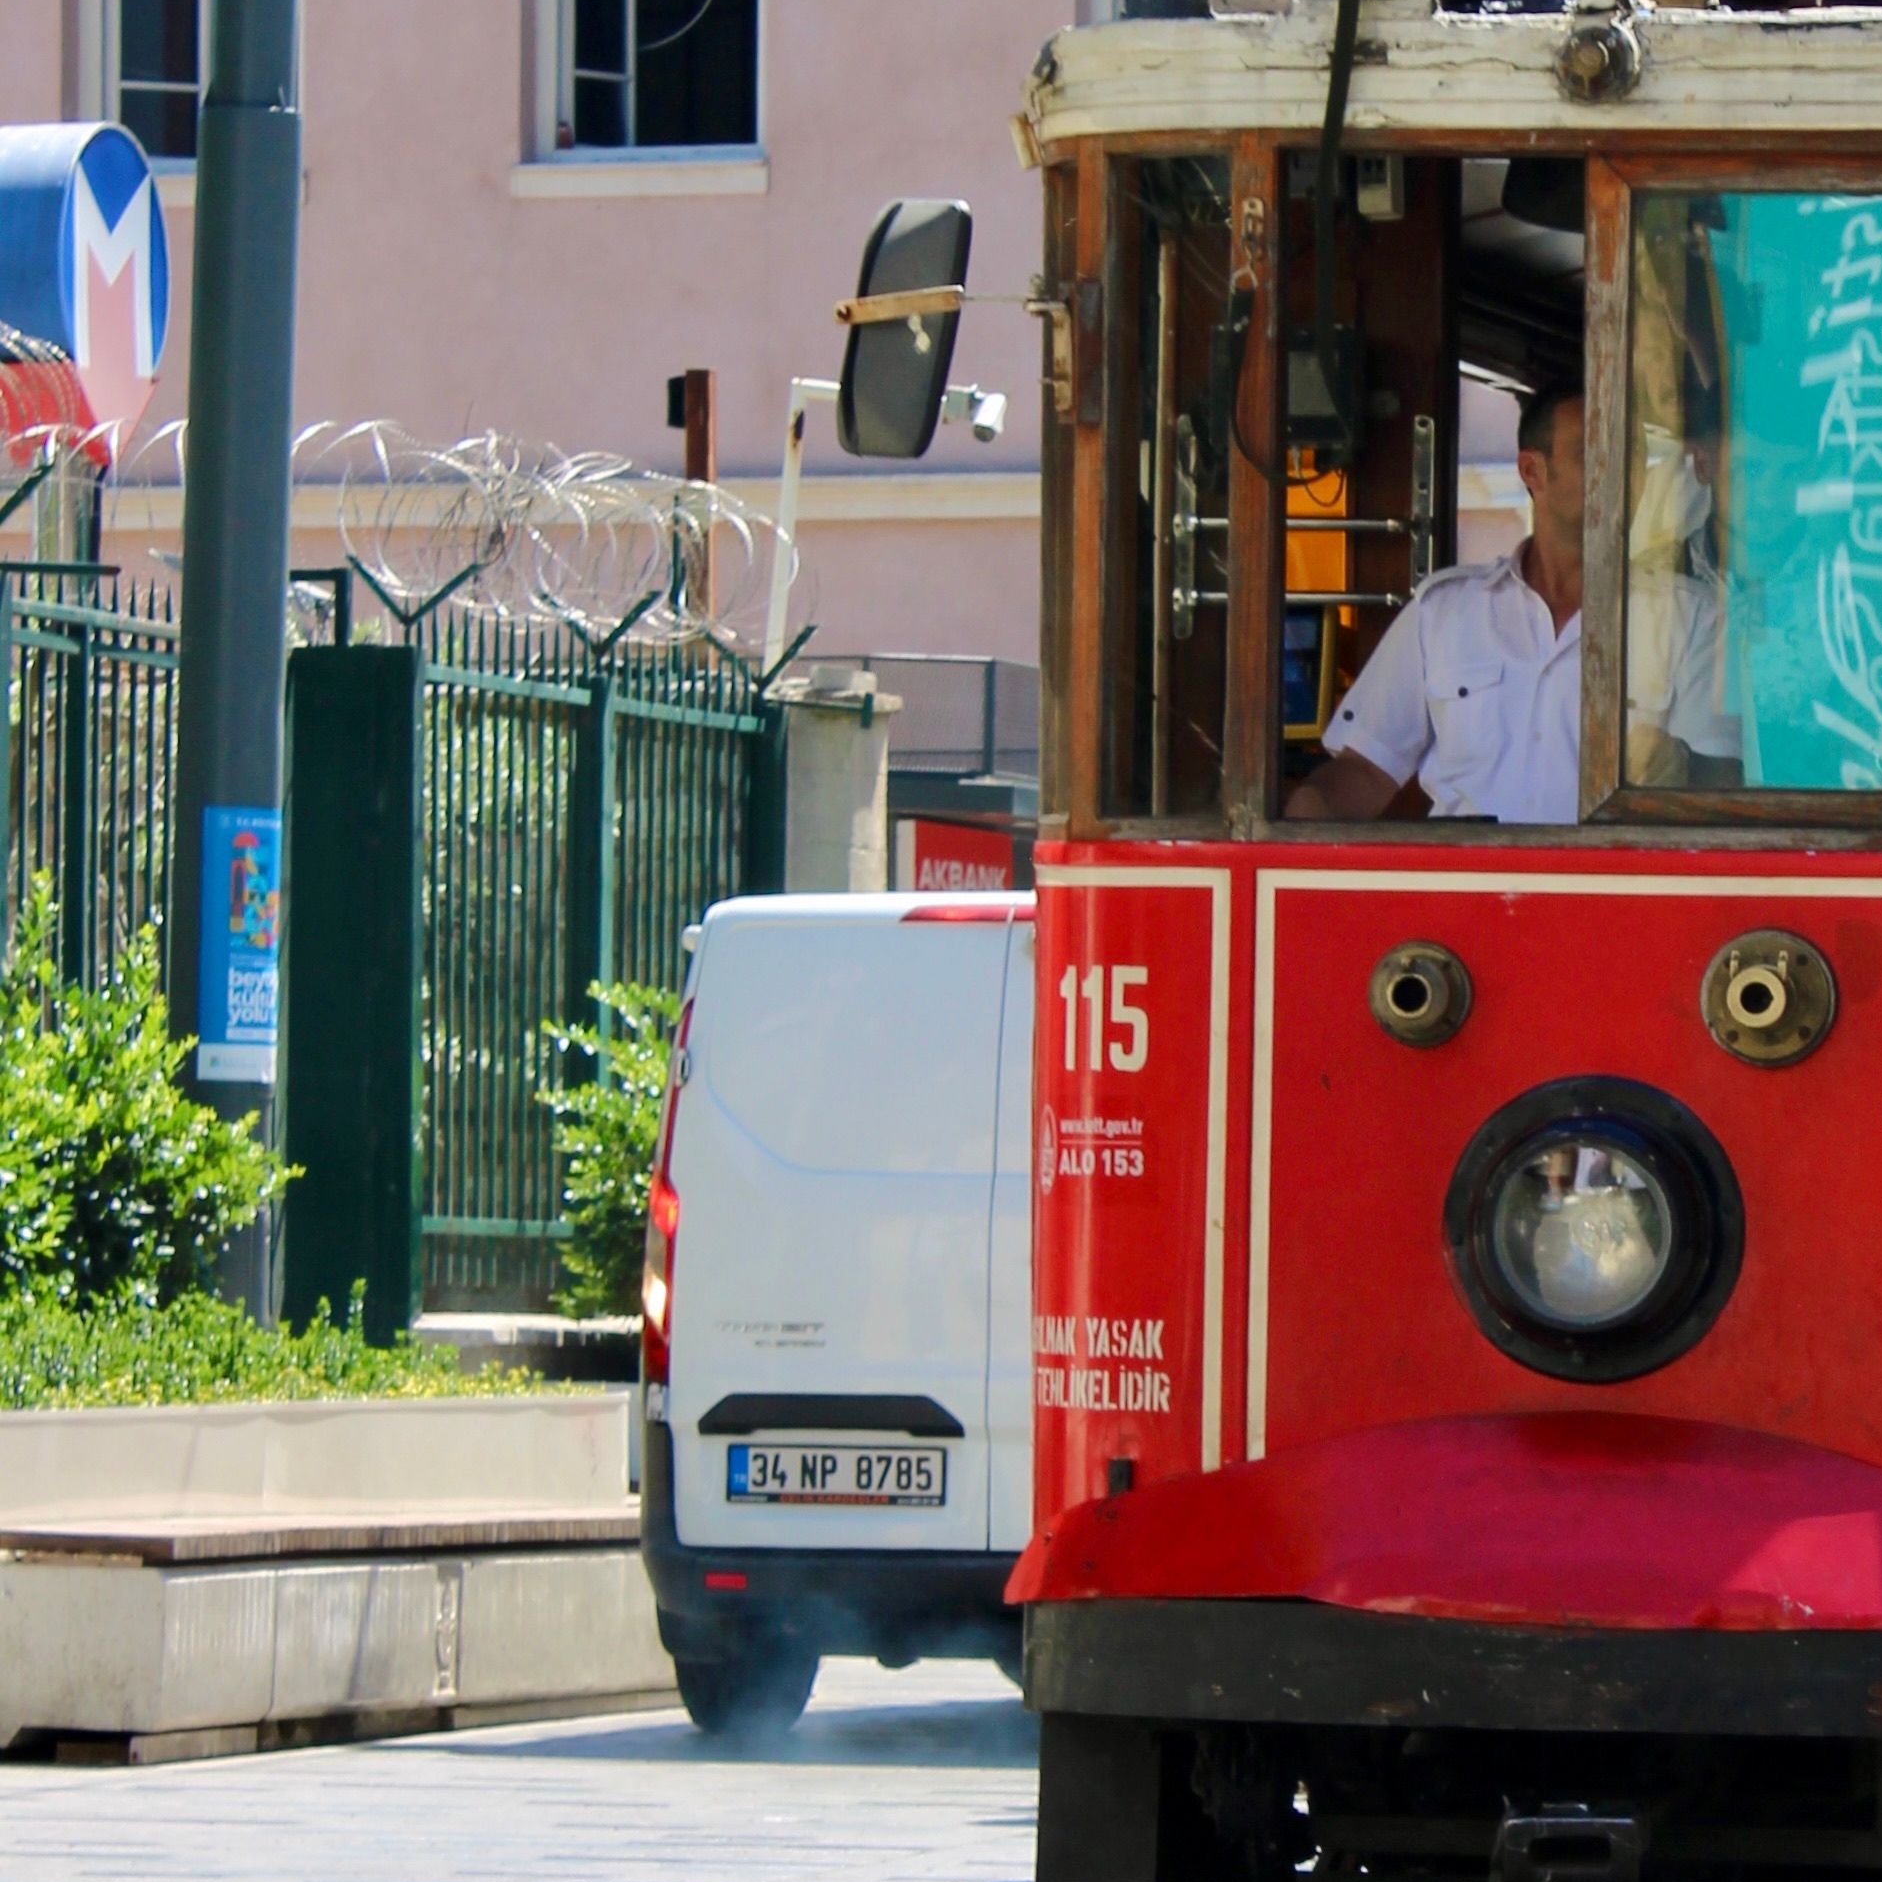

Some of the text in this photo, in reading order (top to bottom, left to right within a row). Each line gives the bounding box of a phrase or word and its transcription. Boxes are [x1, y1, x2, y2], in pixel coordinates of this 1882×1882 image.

[920, 858, 1007, 891] AKBANK
[1060, 965, 1149, 1072] 115
[1059, 1148, 1145, 1177] ALO 153
[1086, 1317, 1164, 1359] YASAK
[751, 1454, 932, 1491] 34 NP 8785
